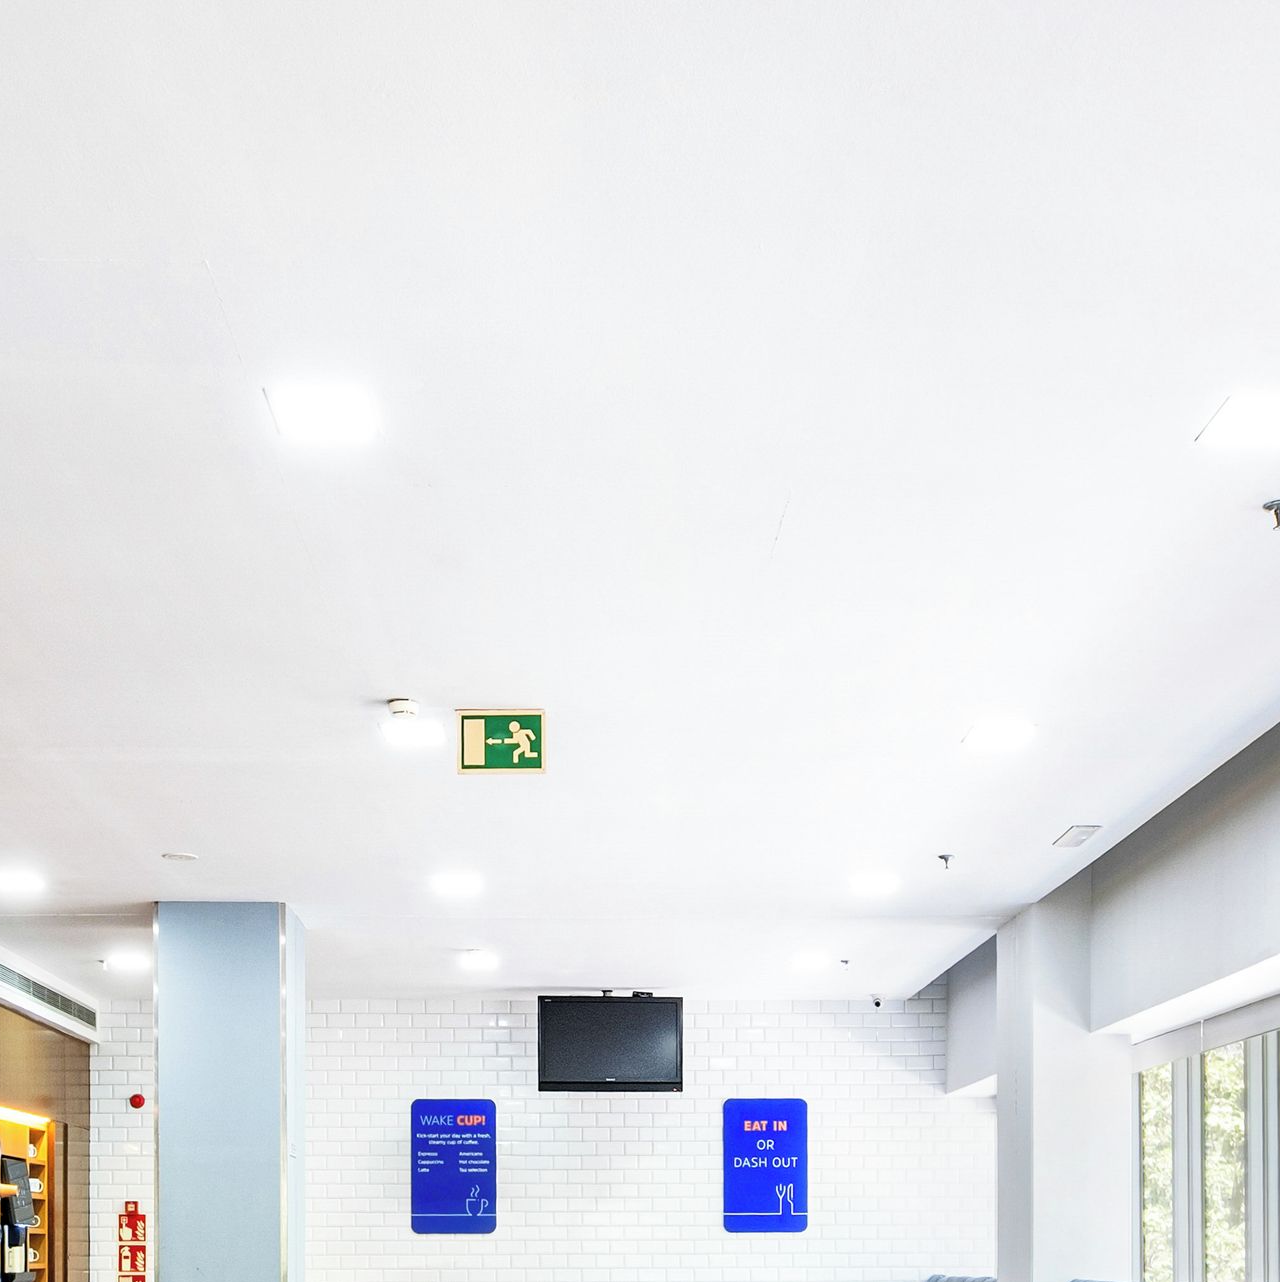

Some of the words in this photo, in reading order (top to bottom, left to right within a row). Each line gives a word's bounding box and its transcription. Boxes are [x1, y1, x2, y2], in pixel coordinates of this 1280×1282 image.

[420, 1115, 454, 1126] WAKE
[456, 1115, 486, 1126] CUP!
[744, 1121, 768, 1131] EAT
[773, 1121, 787, 1131] IN
[756, 1140, 774, 1150] OR
[734, 1157, 767, 1168] DASH
[772, 1157, 798, 1168] OUT
